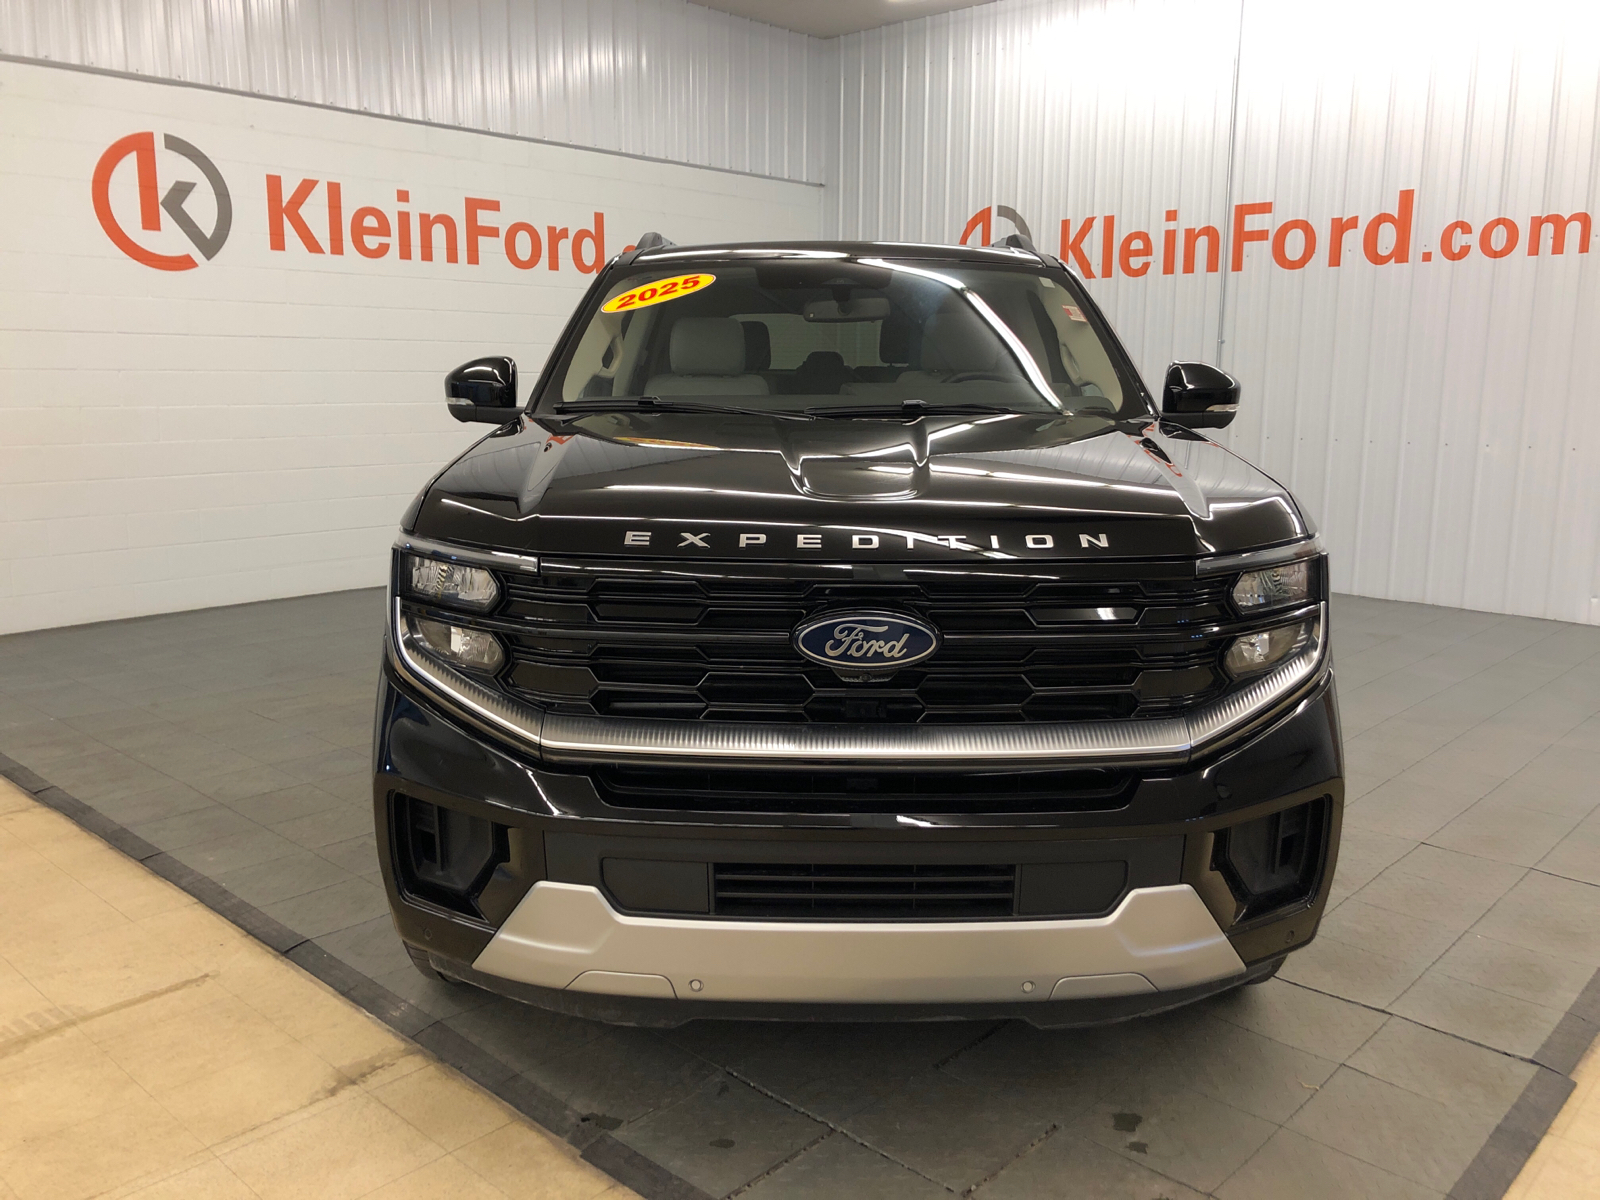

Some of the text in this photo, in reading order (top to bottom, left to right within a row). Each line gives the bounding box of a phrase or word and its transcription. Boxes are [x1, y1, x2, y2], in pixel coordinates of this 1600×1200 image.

[266, 174, 636, 274] KleinFord
[1059, 188, 1591, 279] KleinFord.com
[615, 275, 701, 310] 2025
[623, 530, 1110, 550] EXPEDITION
[824, 623, 908, 659] Ford
